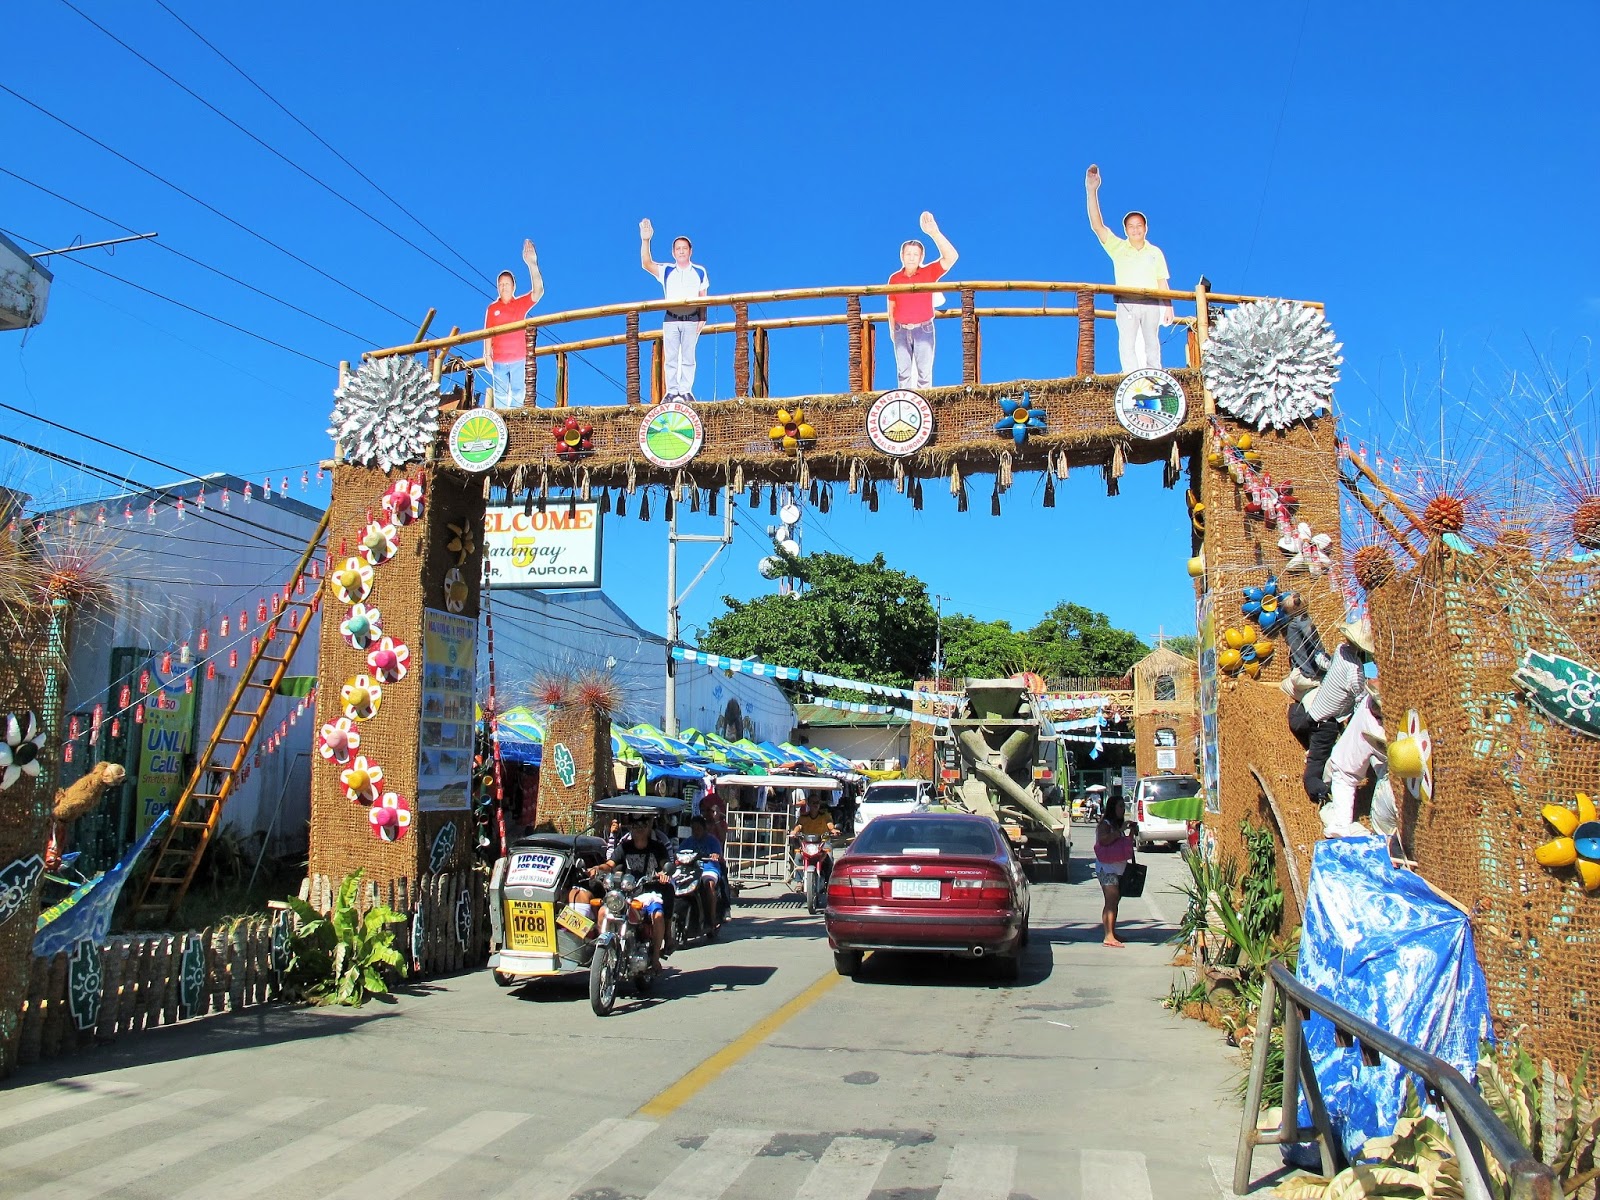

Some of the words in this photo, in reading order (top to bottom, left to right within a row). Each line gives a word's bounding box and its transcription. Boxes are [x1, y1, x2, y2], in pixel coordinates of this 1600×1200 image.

[1116, 371, 1149, 404] BARANGAY
[869, 392, 907, 433] BARANGAY
[910, 395, 931, 431] ZABALI
[450, 413, 472, 446] BARANGAY
[481, 409, 506, 440] POBLACION
[639, 404, 670, 444] BARANGAY
[674, 403, 702, 440] BUHANGIN
[1126, 423, 1150, 438] BALER
[899, 435, 925, 452] AURORA
[484, 509, 593, 533] ELCOME
[489, 545, 567, 565] arangay
[511, 535, 536, 568] 5
[527, 565, 589, 576] AURORA
[147, 728, 187, 753] UNLI
[150, 755, 180, 774] Calls
[160, 787, 167, 797] &
[518, 854, 556, 867] VIDEOKE
[531, 863, 551, 871] RENT
[514, 901, 543, 909] MARIA
[514, 915, 545, 932] 1788
[566, 914, 584, 930] 1788
